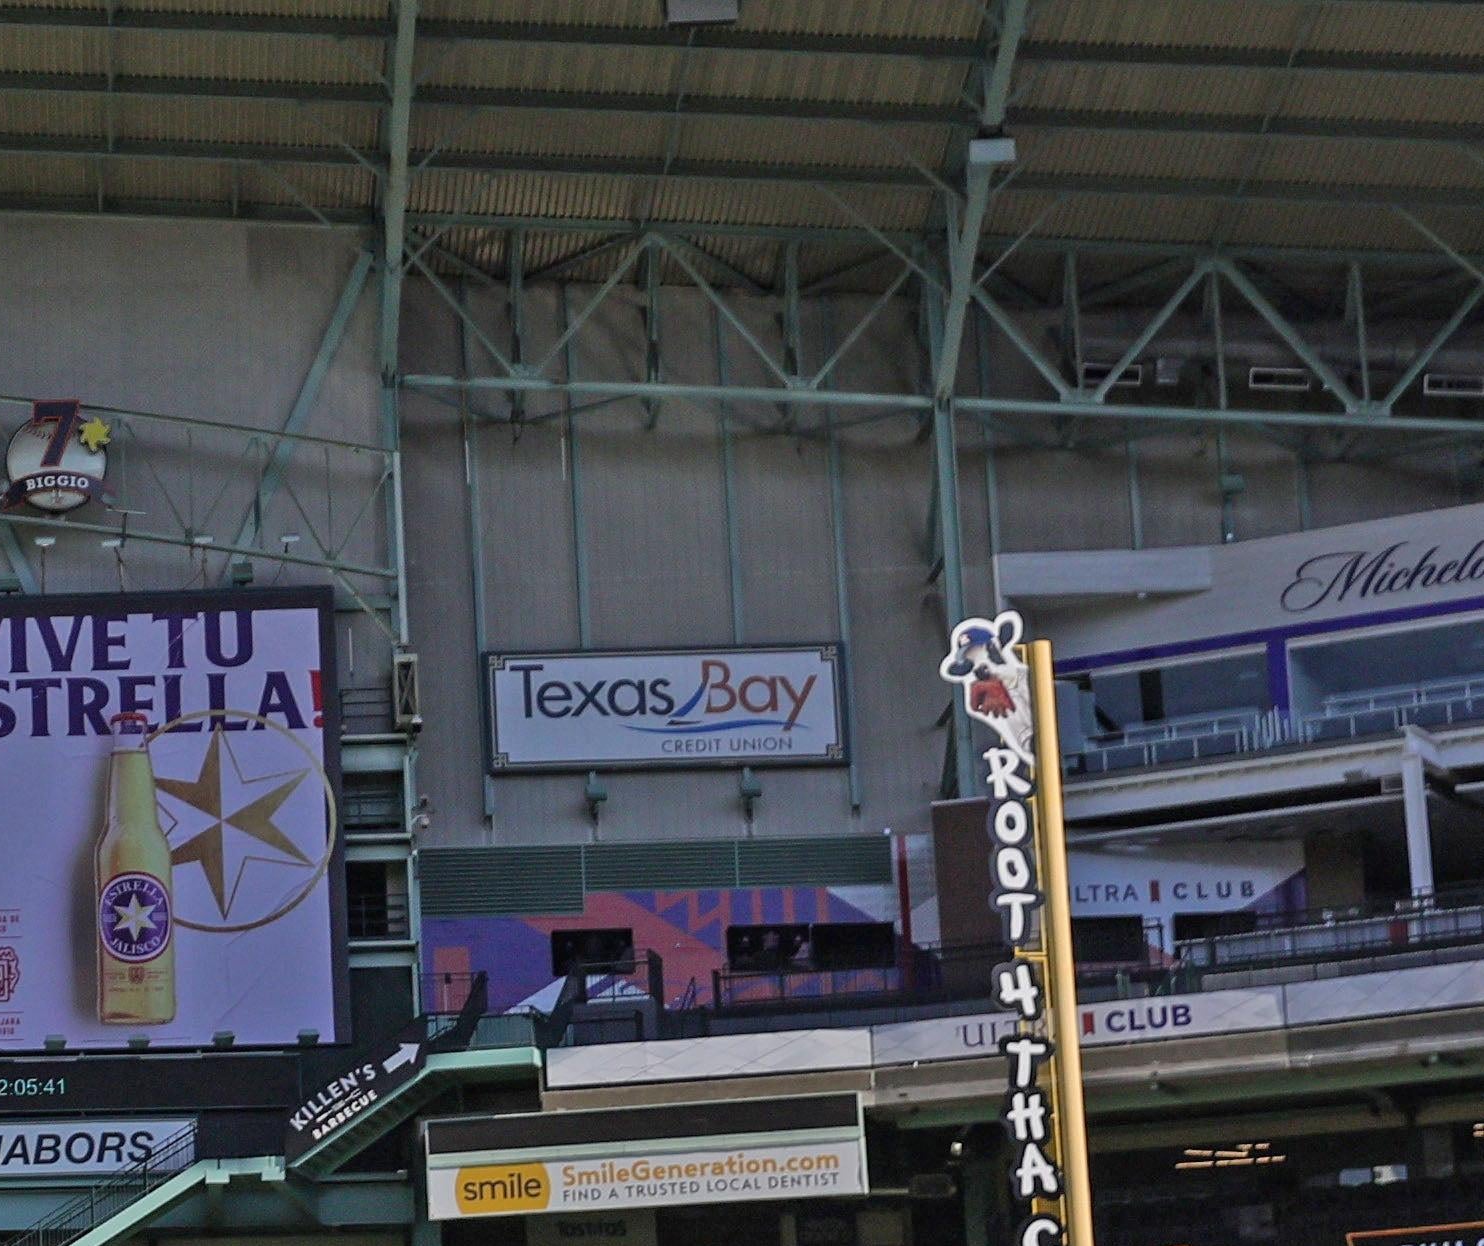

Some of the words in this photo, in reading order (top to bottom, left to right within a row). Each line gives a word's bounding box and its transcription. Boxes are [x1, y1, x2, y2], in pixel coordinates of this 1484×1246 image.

[31, 400, 80, 468] 7
[25, 471, 90, 490] BIGGIO
[151, 608, 255, 669] TU
[509, 663, 676, 719] Texas
[699, 659, 818, 732] Bay
[661, 738, 722, 753] CREDIT
[730, 736, 793, 751] UNION
[983, 747, 1037, 940] ROOT
[1075, 884, 1139, 903] LTRA
[1173, 881, 1255, 898] CLUB
[111, 935, 162, 957] JALISCO
[1000, 970, 1037, 1016] 4
[1105, 1005, 1192, 1033] CLUB
[289, 1063, 377, 1132] KILLEN'S
[312, 1090, 378, 1140] BARBECUE
[1005, 1040, 1058, 1197] THA
[463, 1168, 542, 1202] smile
[562, 1152, 839, 1186] SmileGeneration.com
[563, 1189, 606, 1202] FIND
[608, 1187, 621, 1199] A
[626, 1180, 701, 1199] TRUSTED
[706, 1176, 764, 1194] LOCAL
[768, 1172, 839, 1190] DENTIST
